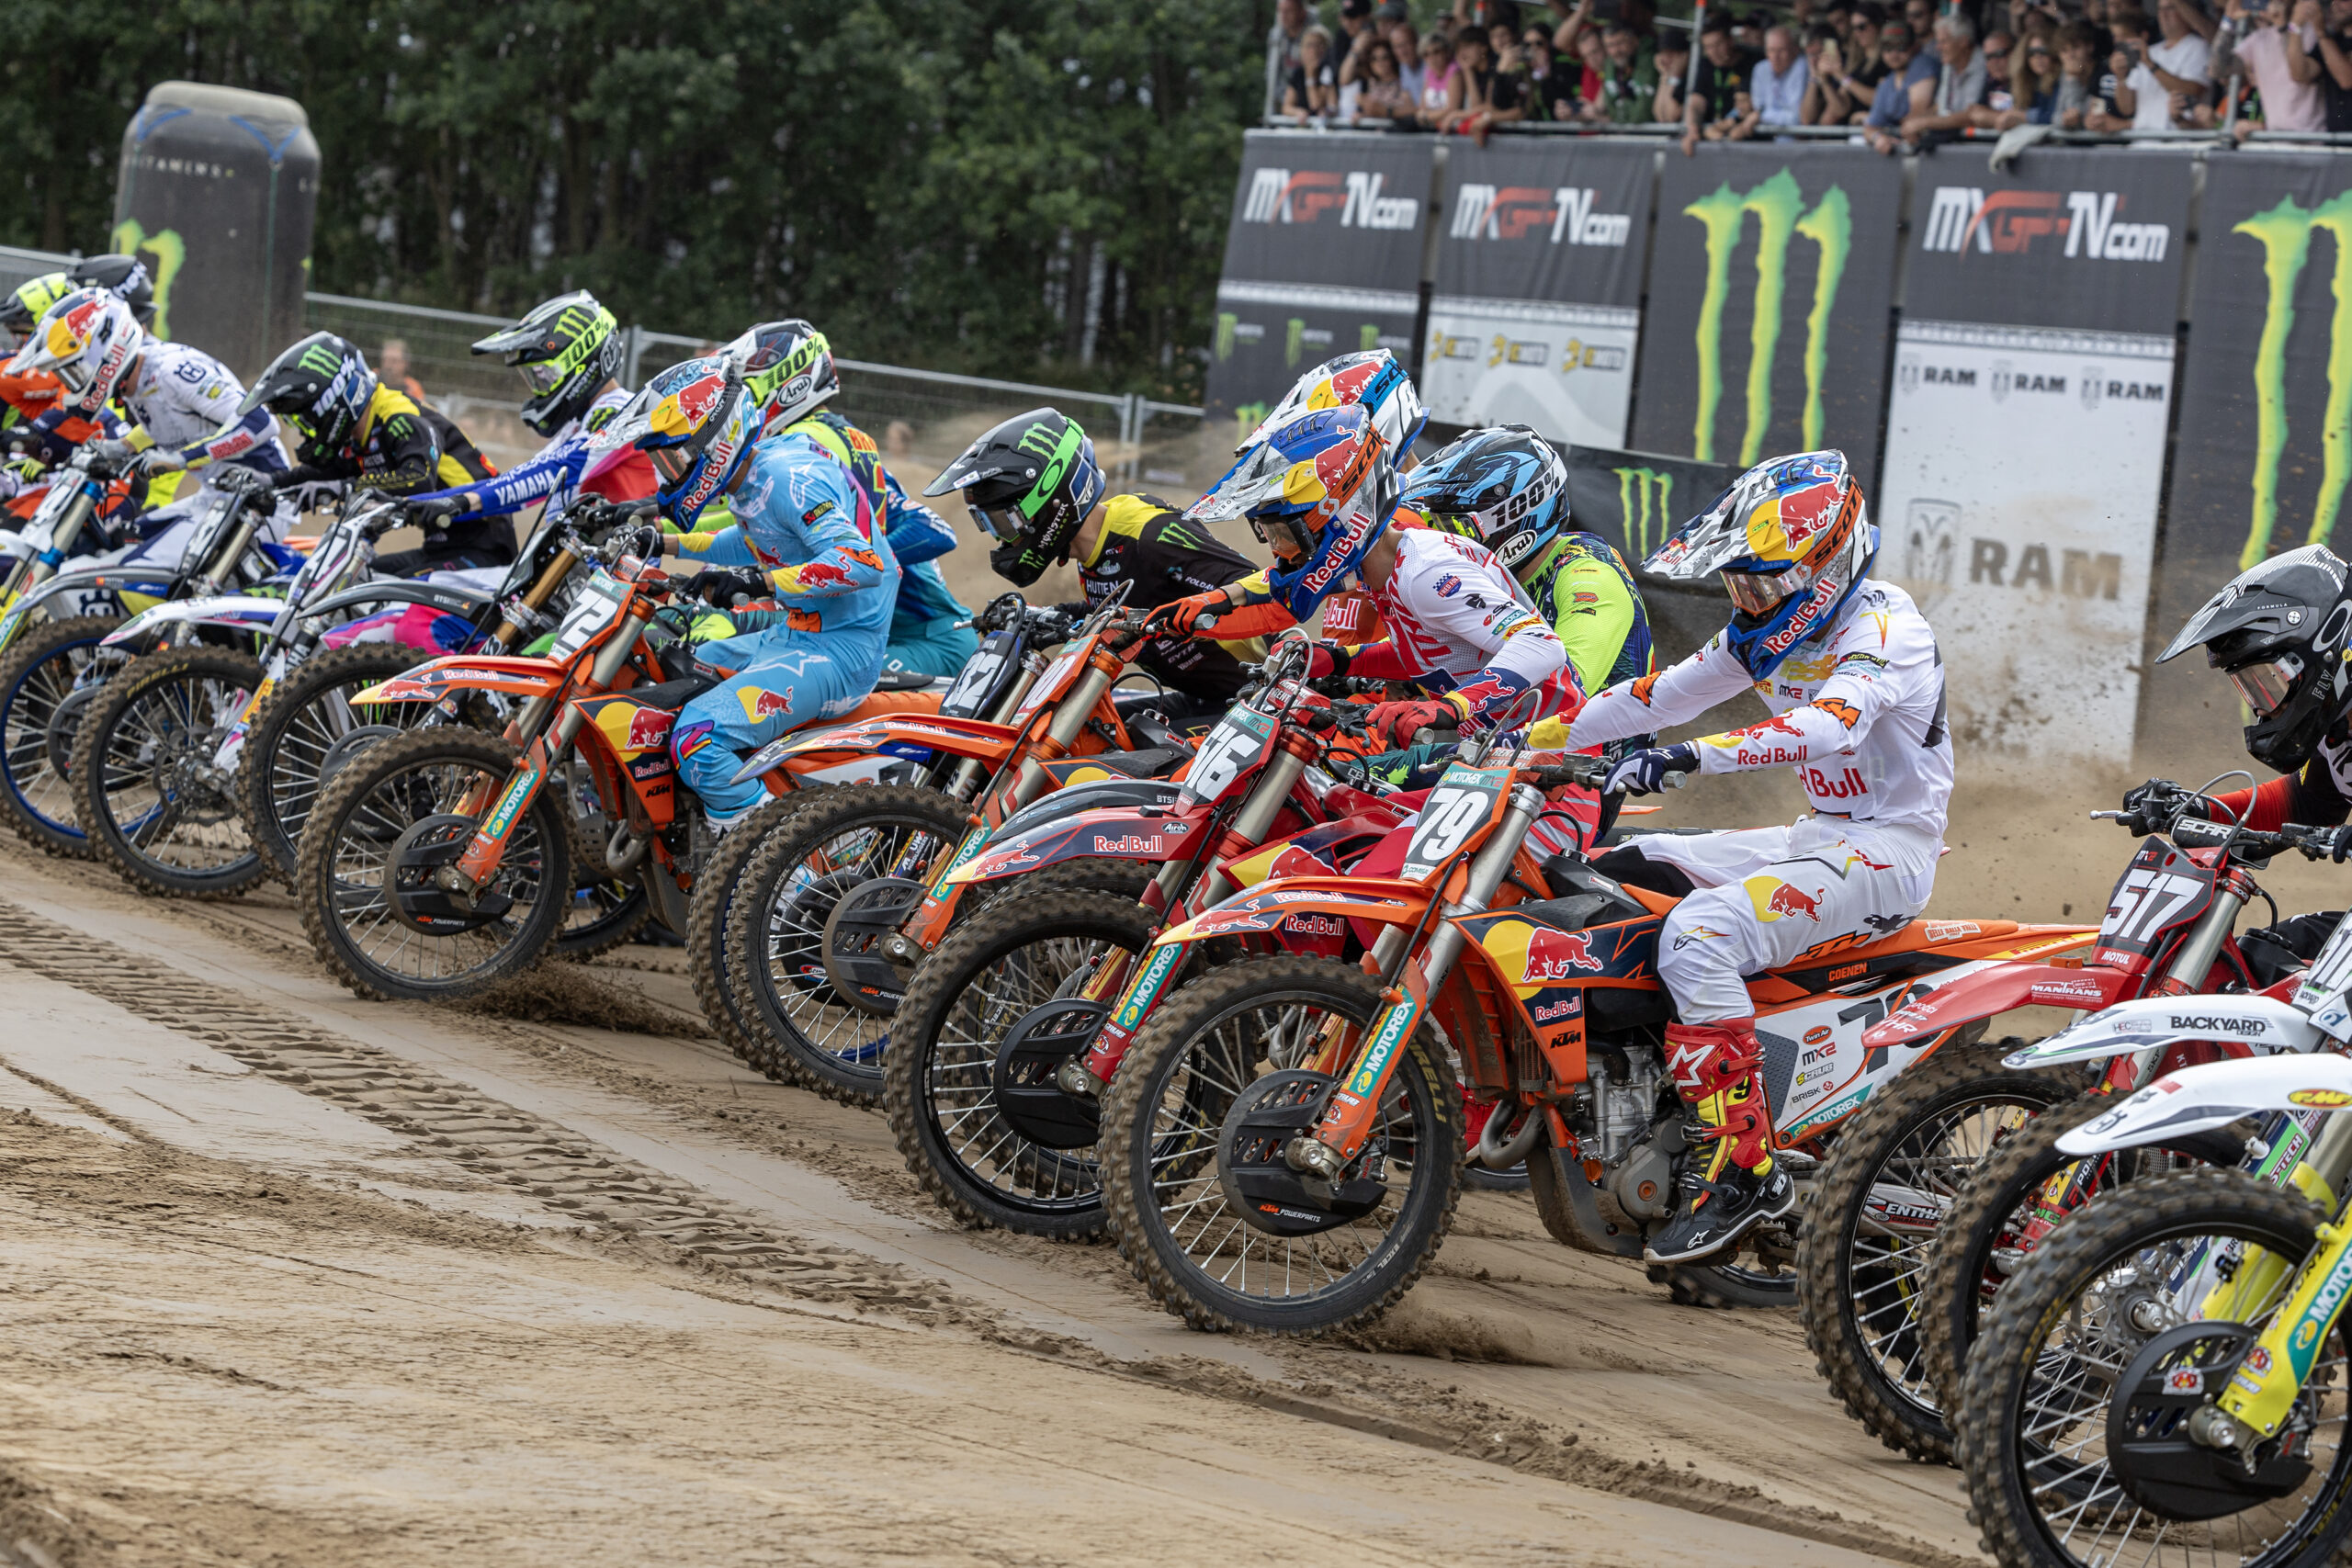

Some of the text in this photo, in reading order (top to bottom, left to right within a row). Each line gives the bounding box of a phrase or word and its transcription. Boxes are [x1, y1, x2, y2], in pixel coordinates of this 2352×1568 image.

[562, 320, 609, 369] 100%
[767, 336, 823, 389] 100%
[82, 344, 126, 412] Red Bull
[783, 378, 810, 400] Arai
[1924, 366, 1976, 388] RAM
[2015, 374, 2066, 395] RAM
[2107, 380, 2165, 402] RAM
[494, 468, 555, 506] YAMAHA
[683, 442, 734, 513] Red Bull
[1491, 467, 1561, 528] 100%
[1038, 502, 1069, 550] MONSTER
[1303, 511, 1372, 594] Red Bull
[1499, 534, 1533, 562] Arai
[1970, 537, 2123, 601] RAM
[1086, 580, 1121, 595] HUTTEN
[559, 588, 618, 650] 72
[1763, 578, 1839, 655] Red Bull
[443, 669, 470, 682] Red
[2312, 669, 2335, 700] FLY
[1737, 744, 1808, 766] Red Bull
[634, 761, 653, 779] Red
[1449, 772, 1484, 785] MOTOREX
[1813, 768, 1868, 799] Bull
[1406, 787, 1489, 862] 79
[2177, 818, 2233, 840] SCAR
[950, 825, 991, 875] OTOREX
[1094, 835, 1163, 852] Red Bull
[2135, 850, 2159, 862] MX2
[1272, 890, 1346, 904] Red Bull
[2099, 868, 2206, 945] 517
[1285, 915, 1346, 936] Red Bull
[2101, 951, 2131, 965] MOTUL
[1132, 942, 1182, 1008] MOTOREX
[1828, 963, 1869, 983] COENEN
[1535, 996, 1581, 1022] Red Bull
[1365, 1000, 1414, 1075] MOTOREX
[1805, 1028, 1831, 1043] Twin Air
[2170, 1016, 2266, 1034] BACKYARD
[1550, 1030, 1583, 1049] KTM
[1802, 1042, 1838, 1066] MX2
[1795, 1062, 1835, 1087] SCRUB
[1792, 1086, 1822, 1104] BRISK
[1807, 1094, 1861, 1126] MOTOREX
[1259, 1203, 1322, 1224] KTM POWERPARTS
[2310, 1251, 2352, 1324] MOTO
